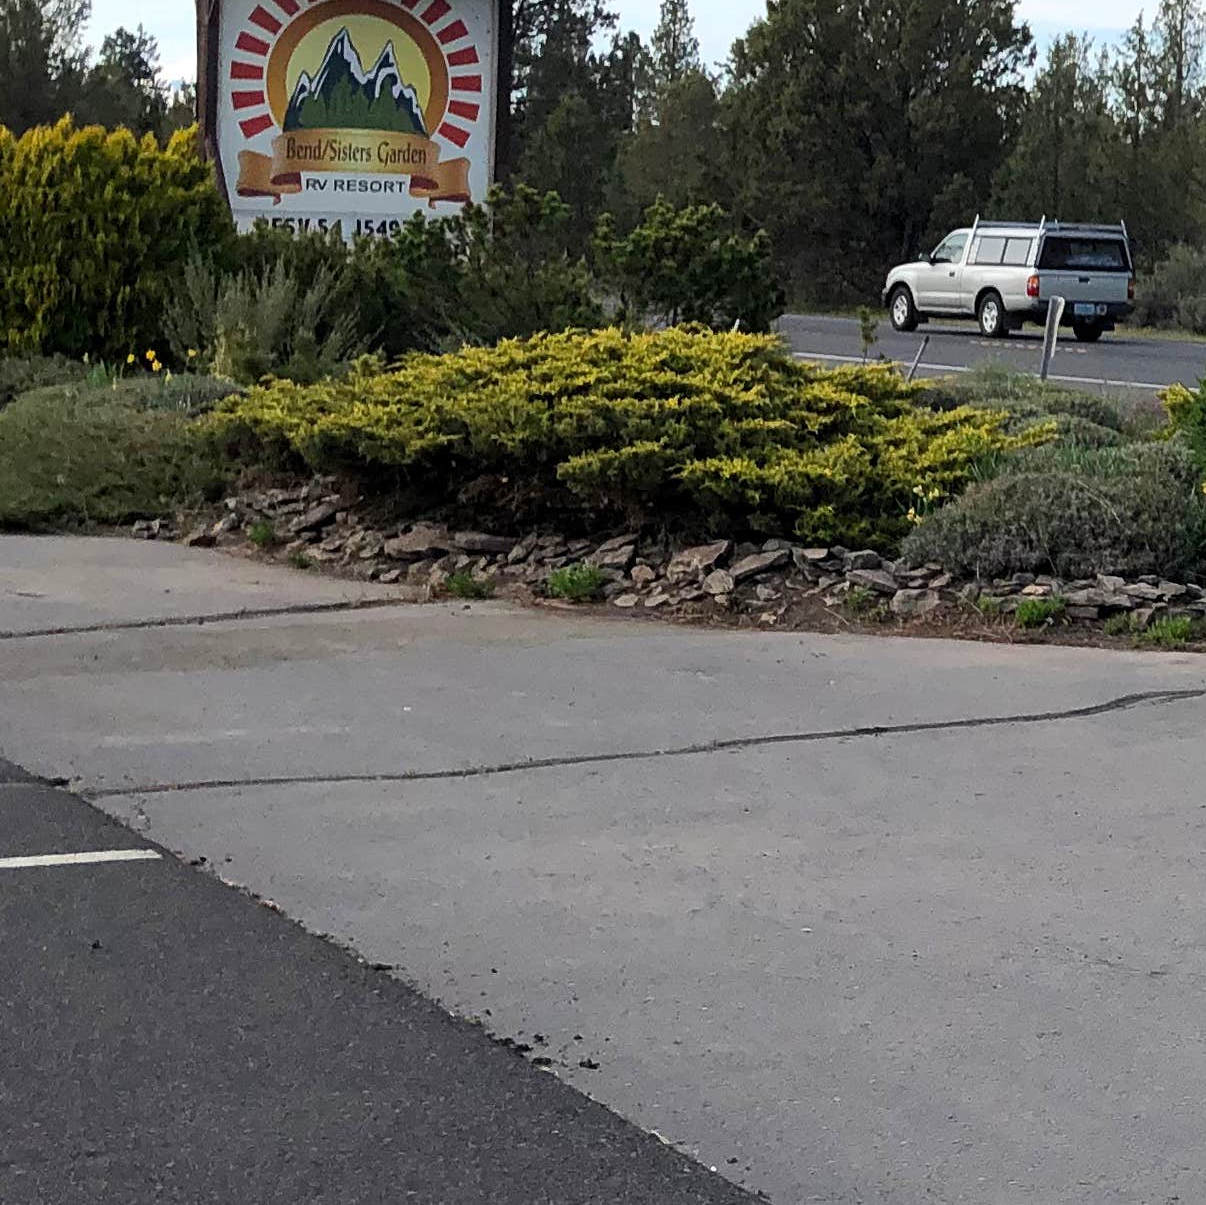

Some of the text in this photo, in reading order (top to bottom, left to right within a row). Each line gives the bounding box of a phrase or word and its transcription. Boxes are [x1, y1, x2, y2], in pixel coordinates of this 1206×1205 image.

[286, 136, 427, 167] Bend/Sisters Garden
[305, 177, 406, 193] RV RESORT
